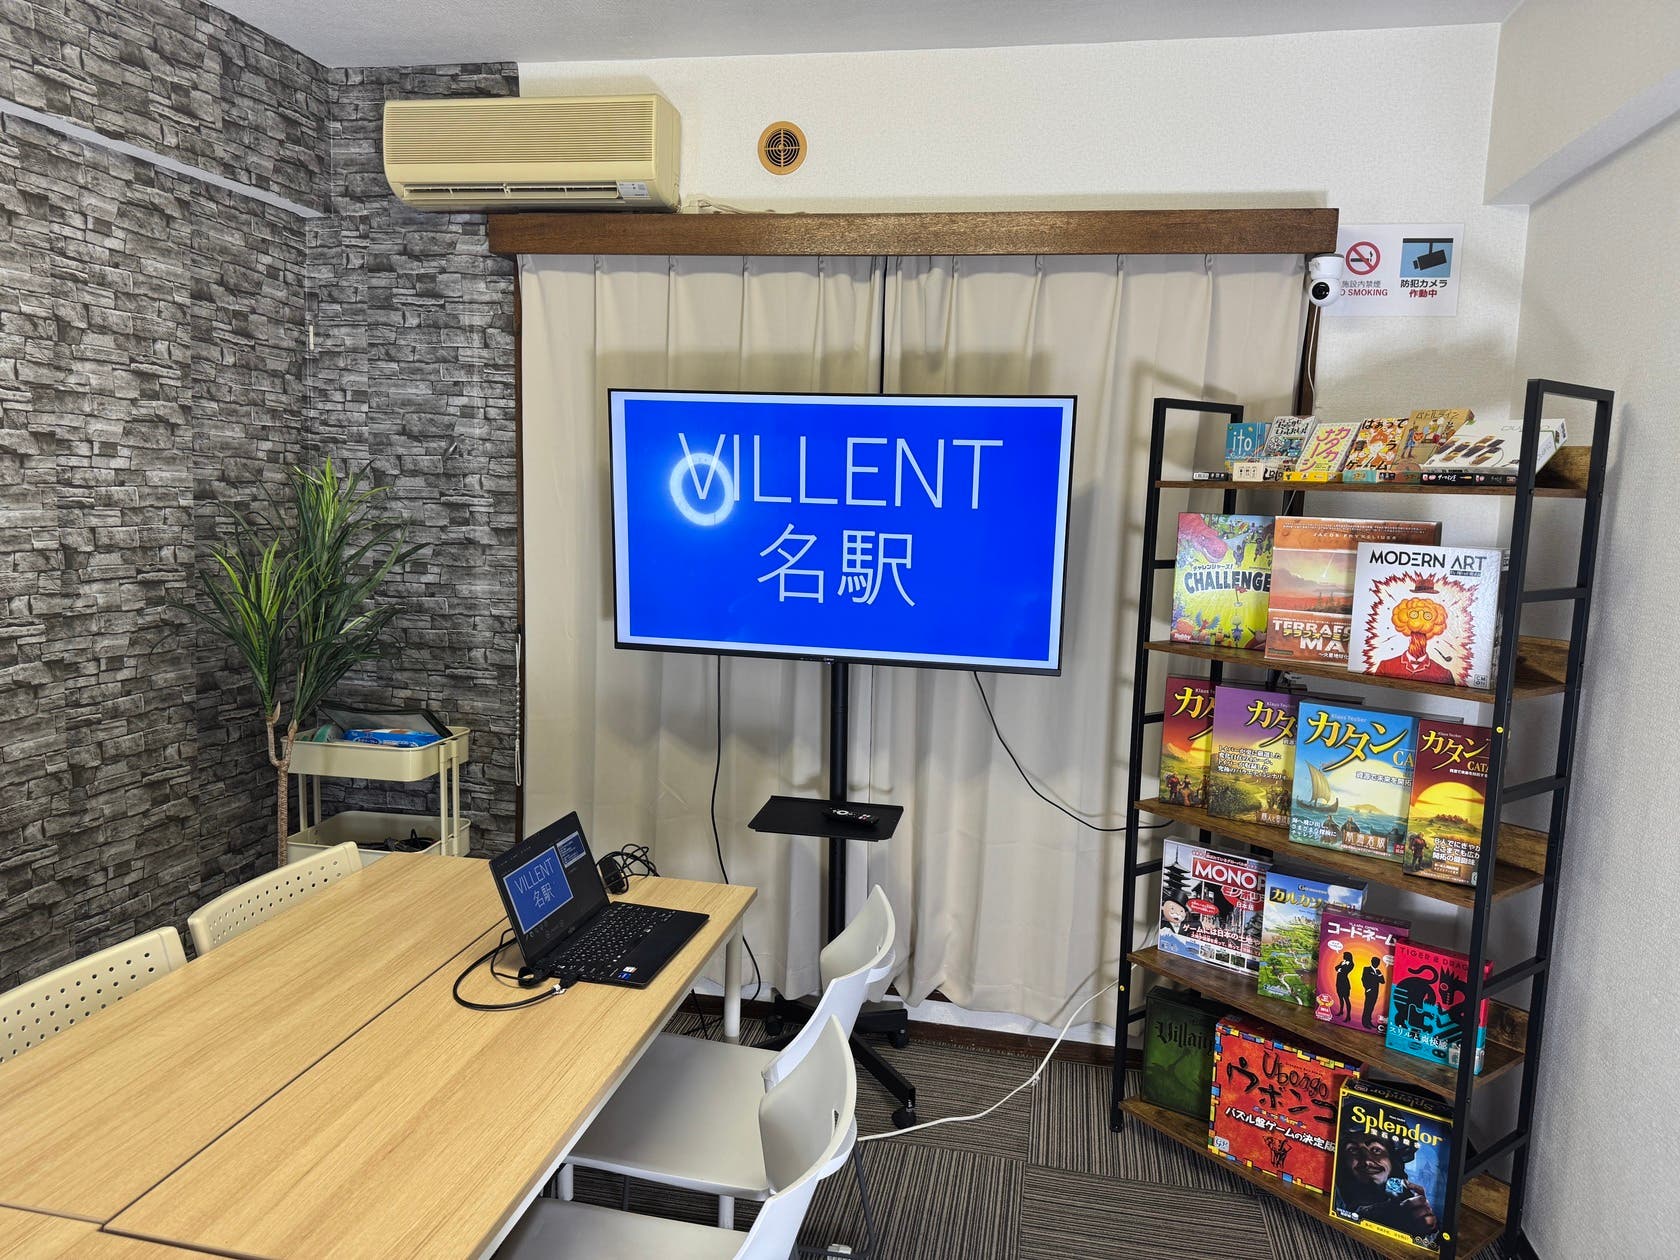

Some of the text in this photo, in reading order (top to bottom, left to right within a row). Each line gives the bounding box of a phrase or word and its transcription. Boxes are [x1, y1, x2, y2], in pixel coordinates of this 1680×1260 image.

[1348, 289, 1388, 297] SMOKING
[1400, 279, 1448, 288] 防犯カメラ
[1409, 289, 1438, 298] 作動中
[1232, 429, 1252, 455] ito
[678, 432, 1003, 509] VILLENT
[757, 523, 915, 607] 名駅
[1369, 549, 1487, 571] MODERN ART
[1184, 570, 1271, 594] CHALLENGE
[1300, 637, 1345, 653] MA
[1304, 710, 1408, 772] カタン
[1420, 730, 1489, 771] カタン
[1467, 761, 1489, 772] CAT
[513, 857, 555, 894] VILLENT
[533, 883, 555, 908] 名駅
[1327, 922, 1398, 947] コードネーム
[1400, 947, 1430, 961] TIGER
[1262, 1050, 1329, 1098] Ubongo
[1225, 1106, 1337, 1153] パズル盤ゲームの決定版
[1351, 1106, 1444, 1147] Splendor
